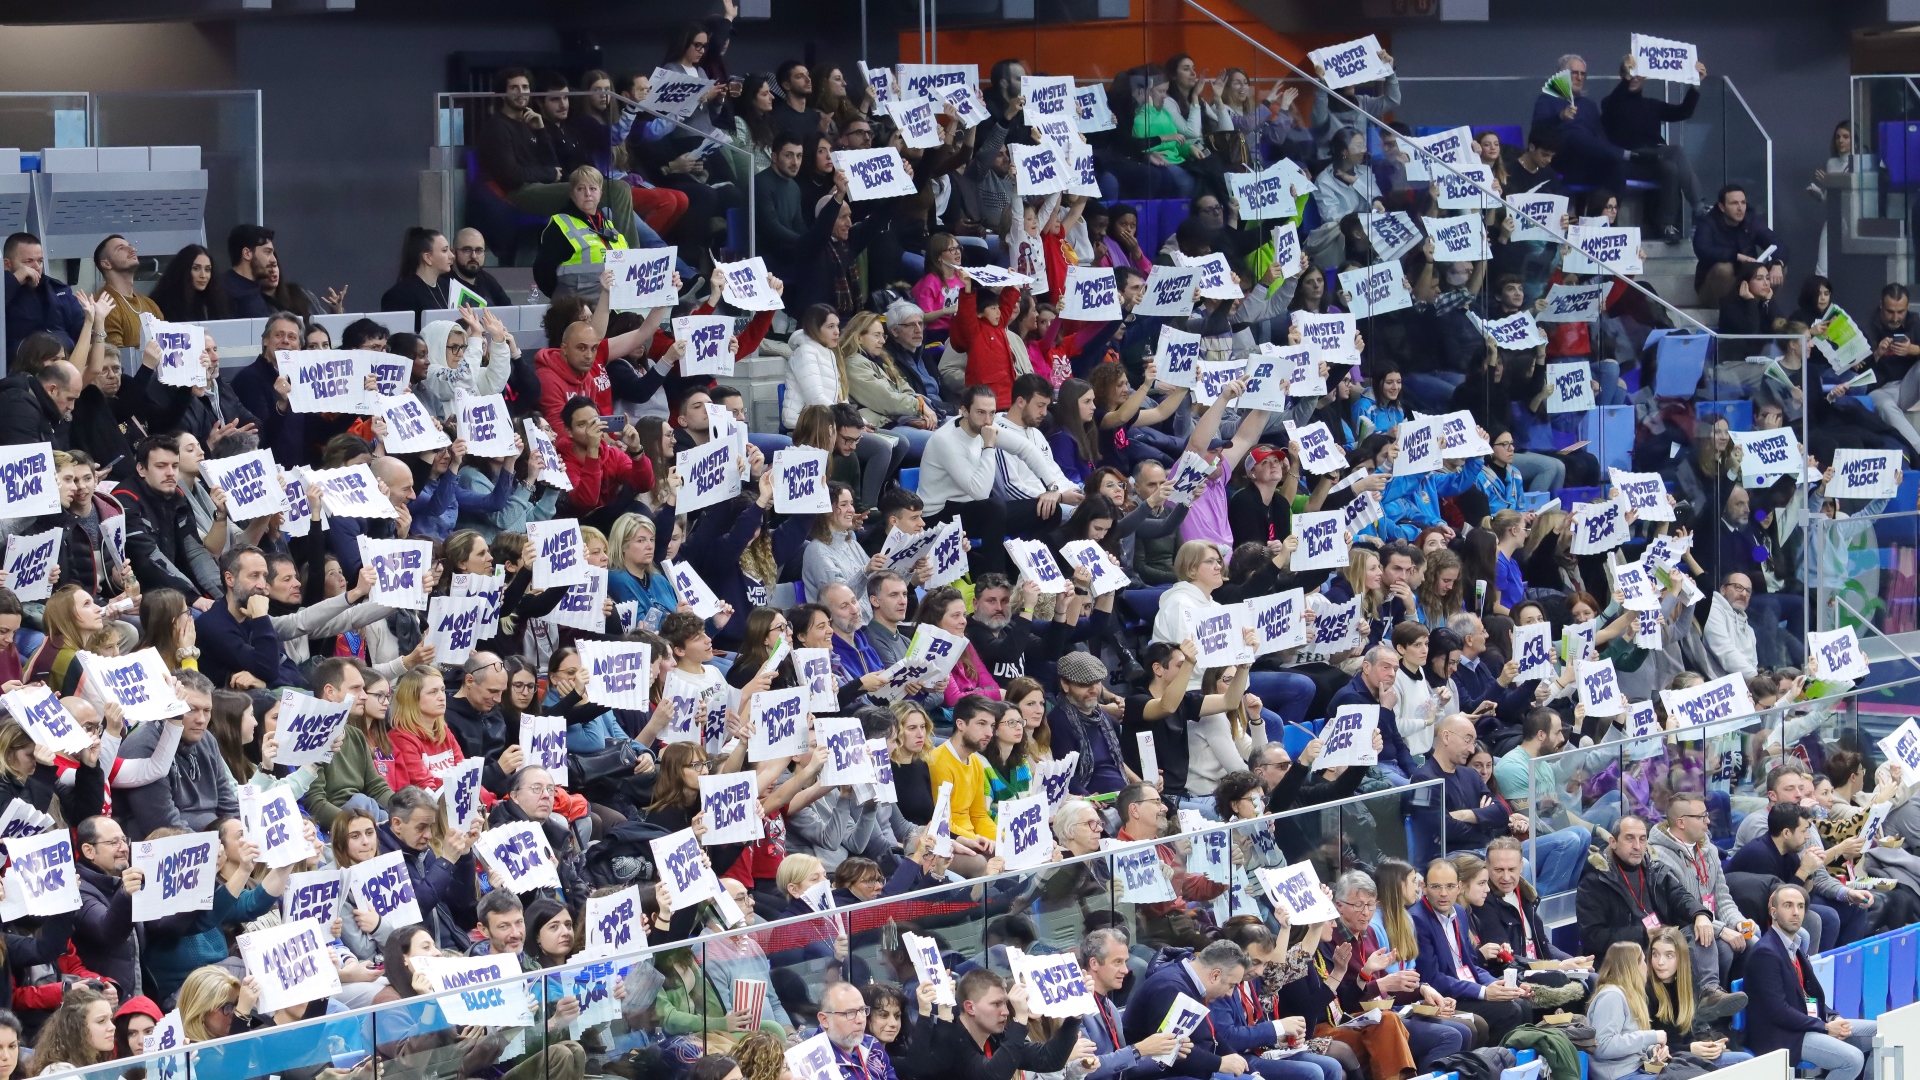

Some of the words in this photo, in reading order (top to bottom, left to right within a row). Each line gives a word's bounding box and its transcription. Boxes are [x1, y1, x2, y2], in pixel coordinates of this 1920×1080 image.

[1323, 45, 1367, 70] MONSTER
[1639, 46, 1688, 60] MONSTER
[1649, 58, 1683, 70] BLOCK
[1335, 59, 1367, 79] BLOCK
[908, 72, 966, 91] MONSTER
[1032, 83, 1067, 103] MONSTER
[1038, 99, 1064, 115] BLOCK
[851, 154, 895, 177] MONSTER
[865, 170, 895, 190] BLOCK
[1237, 177, 1282, 198] MONSTER
[1248, 191, 1280, 210] BLOCK
[1446, 183, 1481, 200] BLOCK
[1435, 221, 1473, 241] MONSTER
[1580, 233, 1627, 251] MONSTER
[1446, 236, 1472, 253] BLOCK
[1074, 275, 1117, 296] MONSTER
[1355, 269, 1393, 297] MONSTER
[1082, 289, 1114, 310] BLOCK
[1155, 288, 1184, 306] BLOCK
[1364, 284, 1392, 306] BLOCK
[1549, 288, 1604, 306] MONSTER
[1553, 300, 1592, 315] BLOCK
[1303, 320, 1346, 338] MONSTER
[300, 359, 354, 385] MONSTER
[1557, 368, 1586, 388] MONSTER
[311, 379, 349, 400] BLOCK
[1560, 381, 1584, 403] BLOCK
[1401, 425, 1432, 452] MONSTER
[1746, 433, 1788, 455] MONSTER
[1407, 441, 1430, 464] BLOCK
[1758, 448, 1789, 466] BLOCK
[0, 452, 47, 483] MONSTER
[218, 459, 267, 493] MONSTER
[689, 446, 730, 485] MONSTER
[782, 459, 819, 484] MONSTER
[1841, 456, 1887, 476] MONSTER
[6, 475, 43, 504] BLOCK
[697, 465, 726, 498] BLOCK
[788, 478, 815, 501] BLOCK
[1619, 479, 1661, 500] MONSTER
[1847, 470, 1879, 488] BLOCK
[1344, 494, 1368, 527] LOCK
[1302, 518, 1338, 542] MONSTER
[1307, 535, 1334, 559] BLOCK
[1677, 683, 1736, 717] MONSTER
[703, 780, 751, 814] MONSTER
[713, 803, 747, 831] BLOCK
[156, 842, 211, 883] MONSTER
[162, 867, 201, 902] BLOCK
[262, 929, 320, 975] MONSTER
[276, 954, 319, 992] BLOCK
[440, 964, 502, 991] MONSTER
[460, 986, 506, 1012] BLOCK
